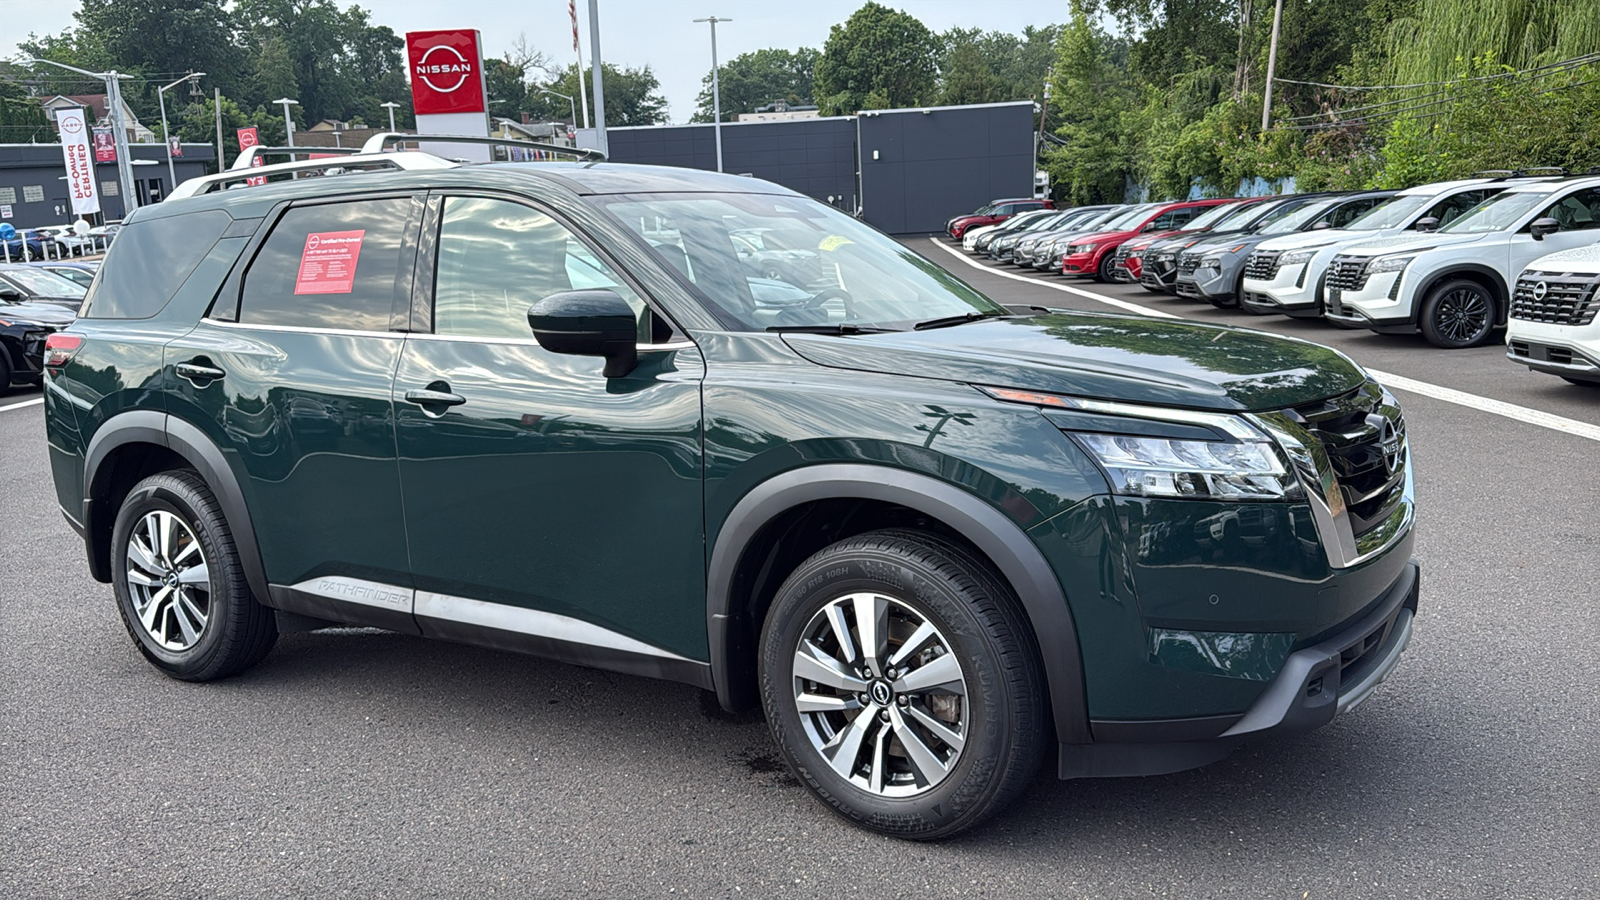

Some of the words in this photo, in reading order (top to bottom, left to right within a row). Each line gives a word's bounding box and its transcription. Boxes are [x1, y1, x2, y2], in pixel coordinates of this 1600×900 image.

[416, 64, 471, 74] NISSAN
[807, 574, 824, 589] R18
[825, 566, 849, 579] 108H
[318, 580, 411, 606] PATHFINDER
[971, 653, 998, 739] KUMHO
[797, 767, 864, 820] CRUGEN
